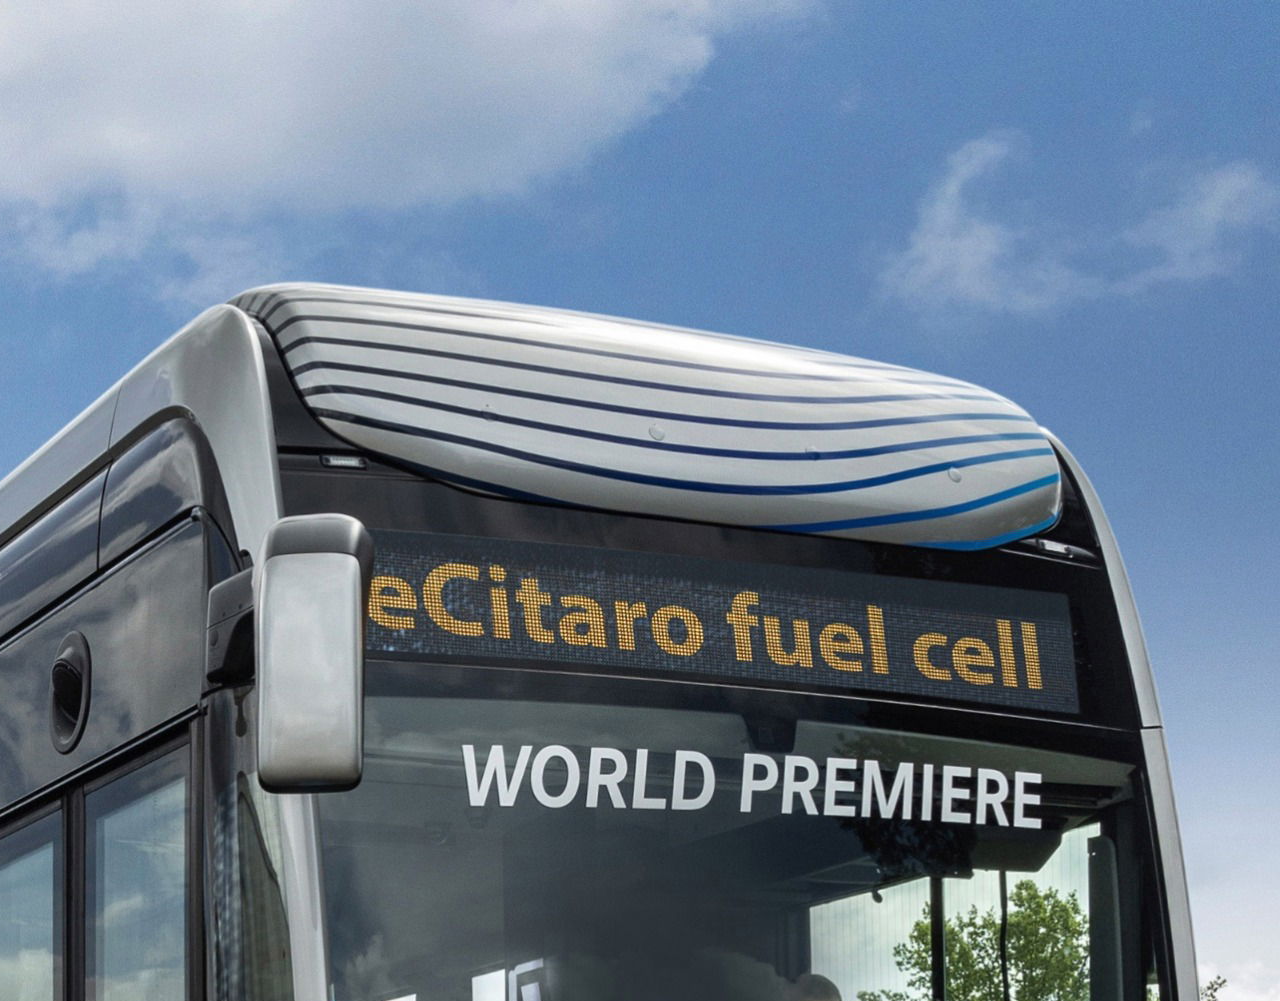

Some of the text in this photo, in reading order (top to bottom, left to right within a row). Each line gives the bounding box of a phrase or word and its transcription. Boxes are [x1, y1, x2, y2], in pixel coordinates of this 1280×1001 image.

[368, 563, 1043, 690] eCitaro fuel cell
[462, 744, 1043, 830] WORLD PREMIERE
